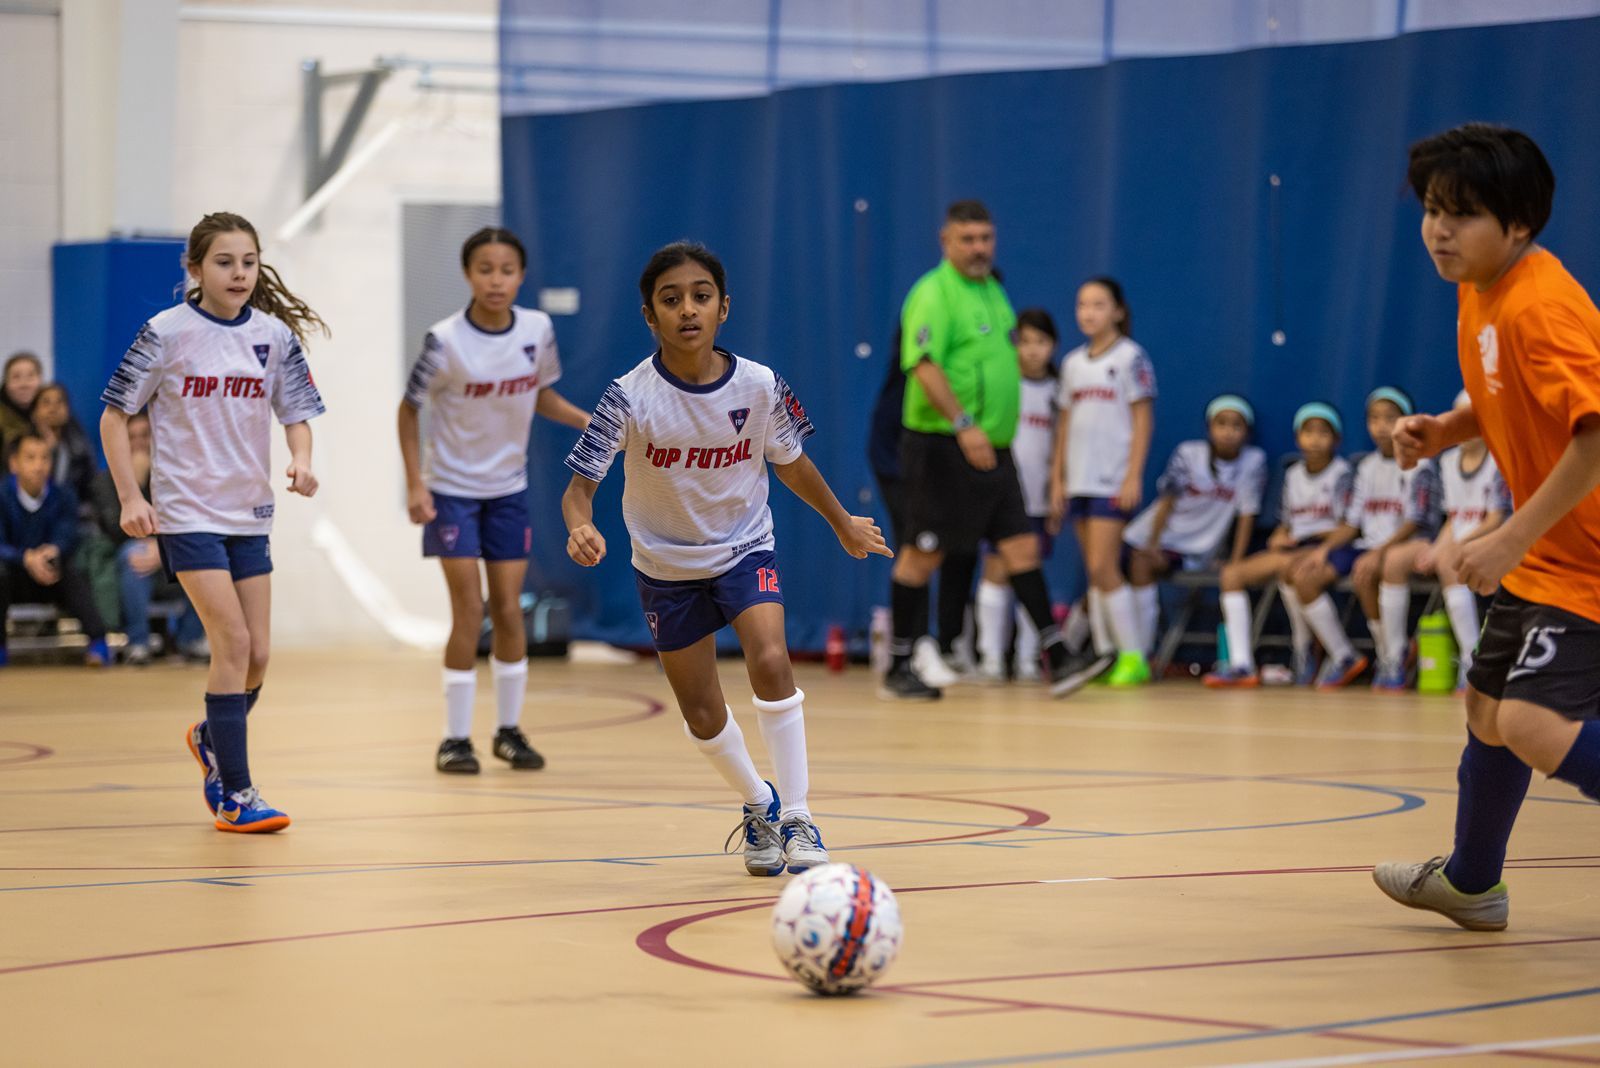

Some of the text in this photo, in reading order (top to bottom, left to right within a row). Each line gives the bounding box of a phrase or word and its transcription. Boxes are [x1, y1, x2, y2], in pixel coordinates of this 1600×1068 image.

[181, 376, 219, 398] FDP
[684, 438, 753, 469] FUTSAL
[756, 567, 780, 593] 12
[1515, 626, 1567, 669] 15
